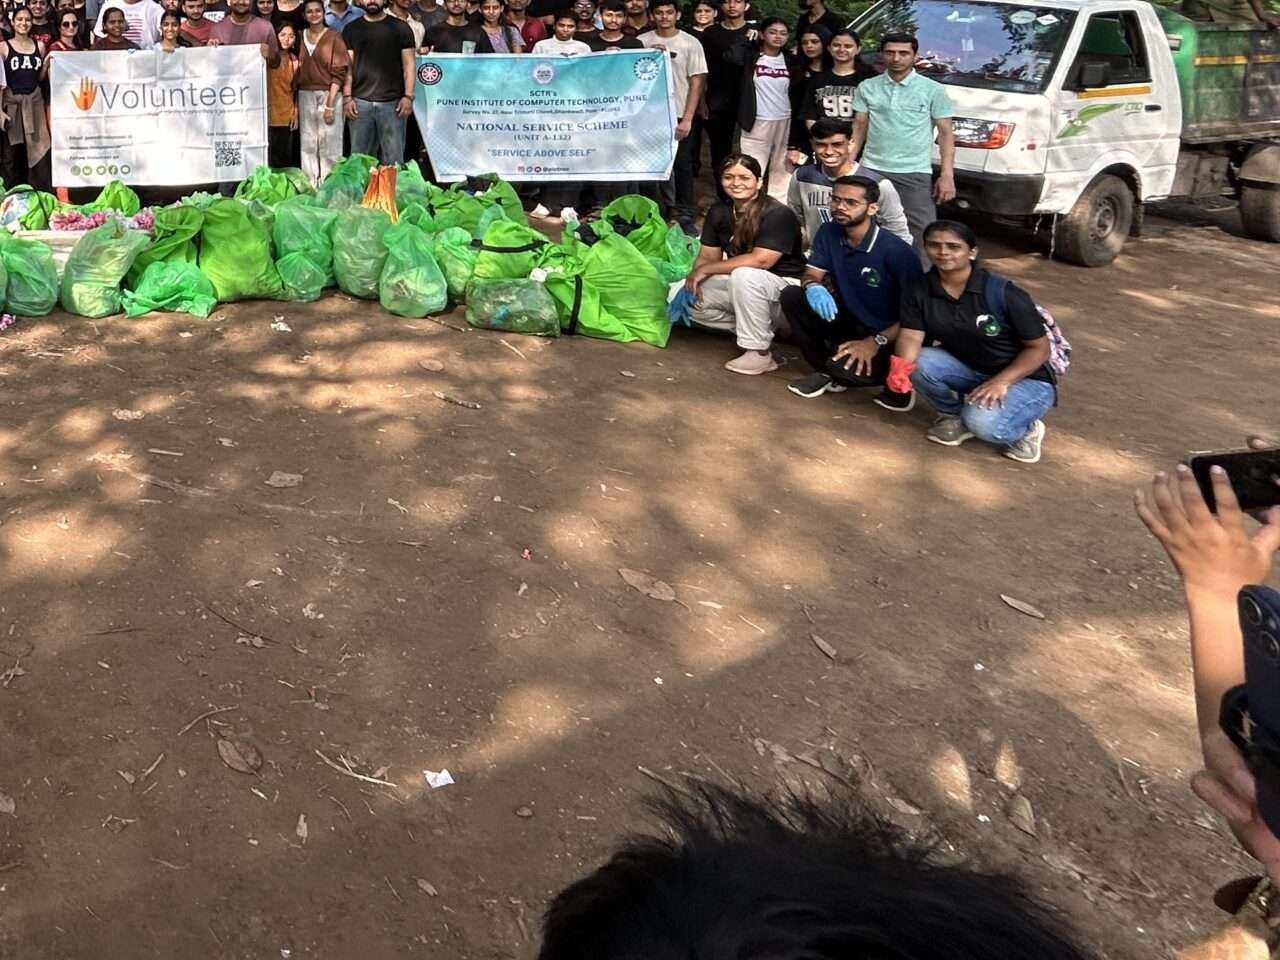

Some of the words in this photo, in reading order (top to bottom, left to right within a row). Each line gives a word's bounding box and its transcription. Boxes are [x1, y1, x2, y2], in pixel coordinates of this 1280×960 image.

[10, 55, 42, 71] GAP
[822, 95, 854, 117] 96
[456, 122, 519, 132] NATIONAL
[522, 122, 574, 132] SERVICE
[577, 120, 628, 131] SCHEME
[513, 134, 540, 142] (UNIT
[533, 148, 569, 157] ABOVE
